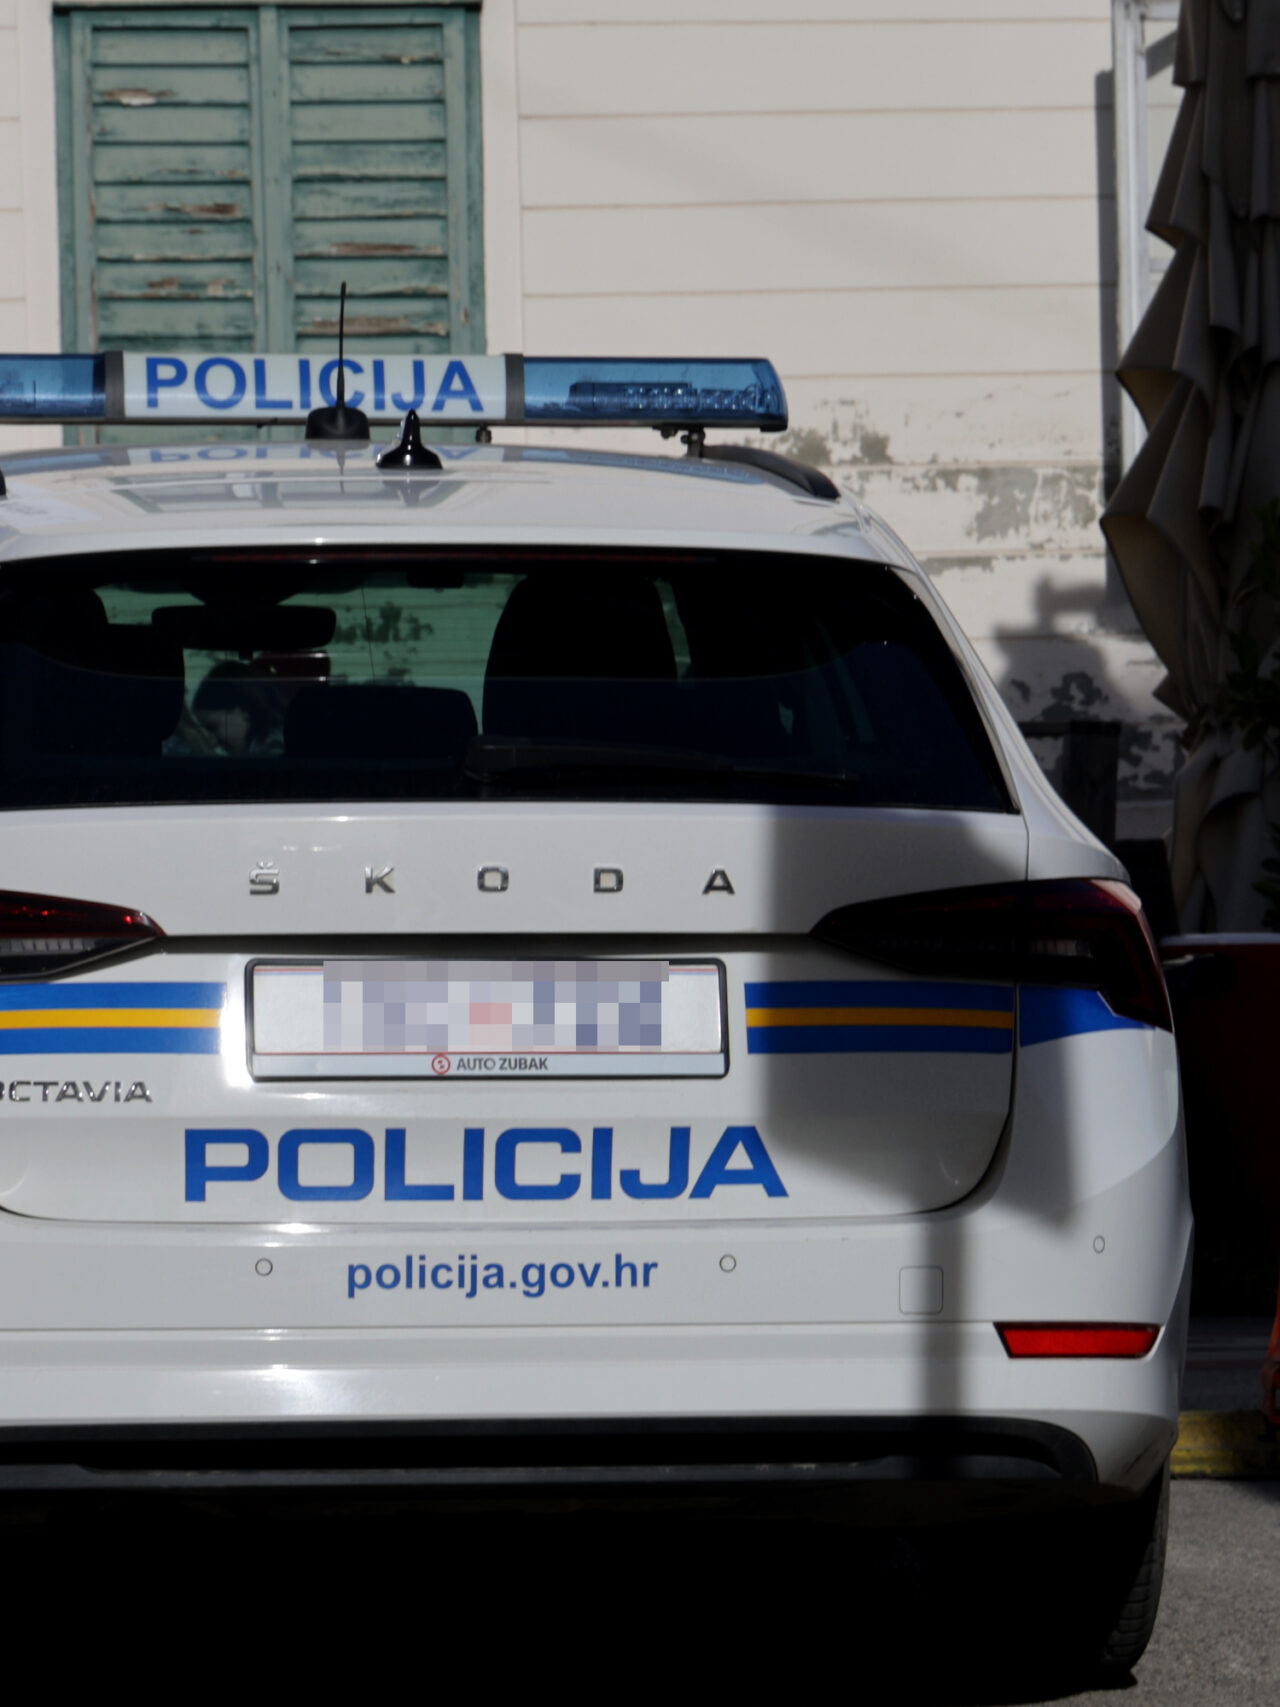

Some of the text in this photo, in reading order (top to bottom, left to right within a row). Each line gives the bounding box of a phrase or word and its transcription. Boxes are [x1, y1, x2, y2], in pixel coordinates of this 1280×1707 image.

[145, 355, 485, 413] POLICIJA
[247, 860, 736, 896] ŠKODA
[456, 1056, 549, 1071] AUTO ZUBAK
[184, 1125, 789, 1203] POLICIJA
[347, 1253, 659, 1299] policija.gov.hr
